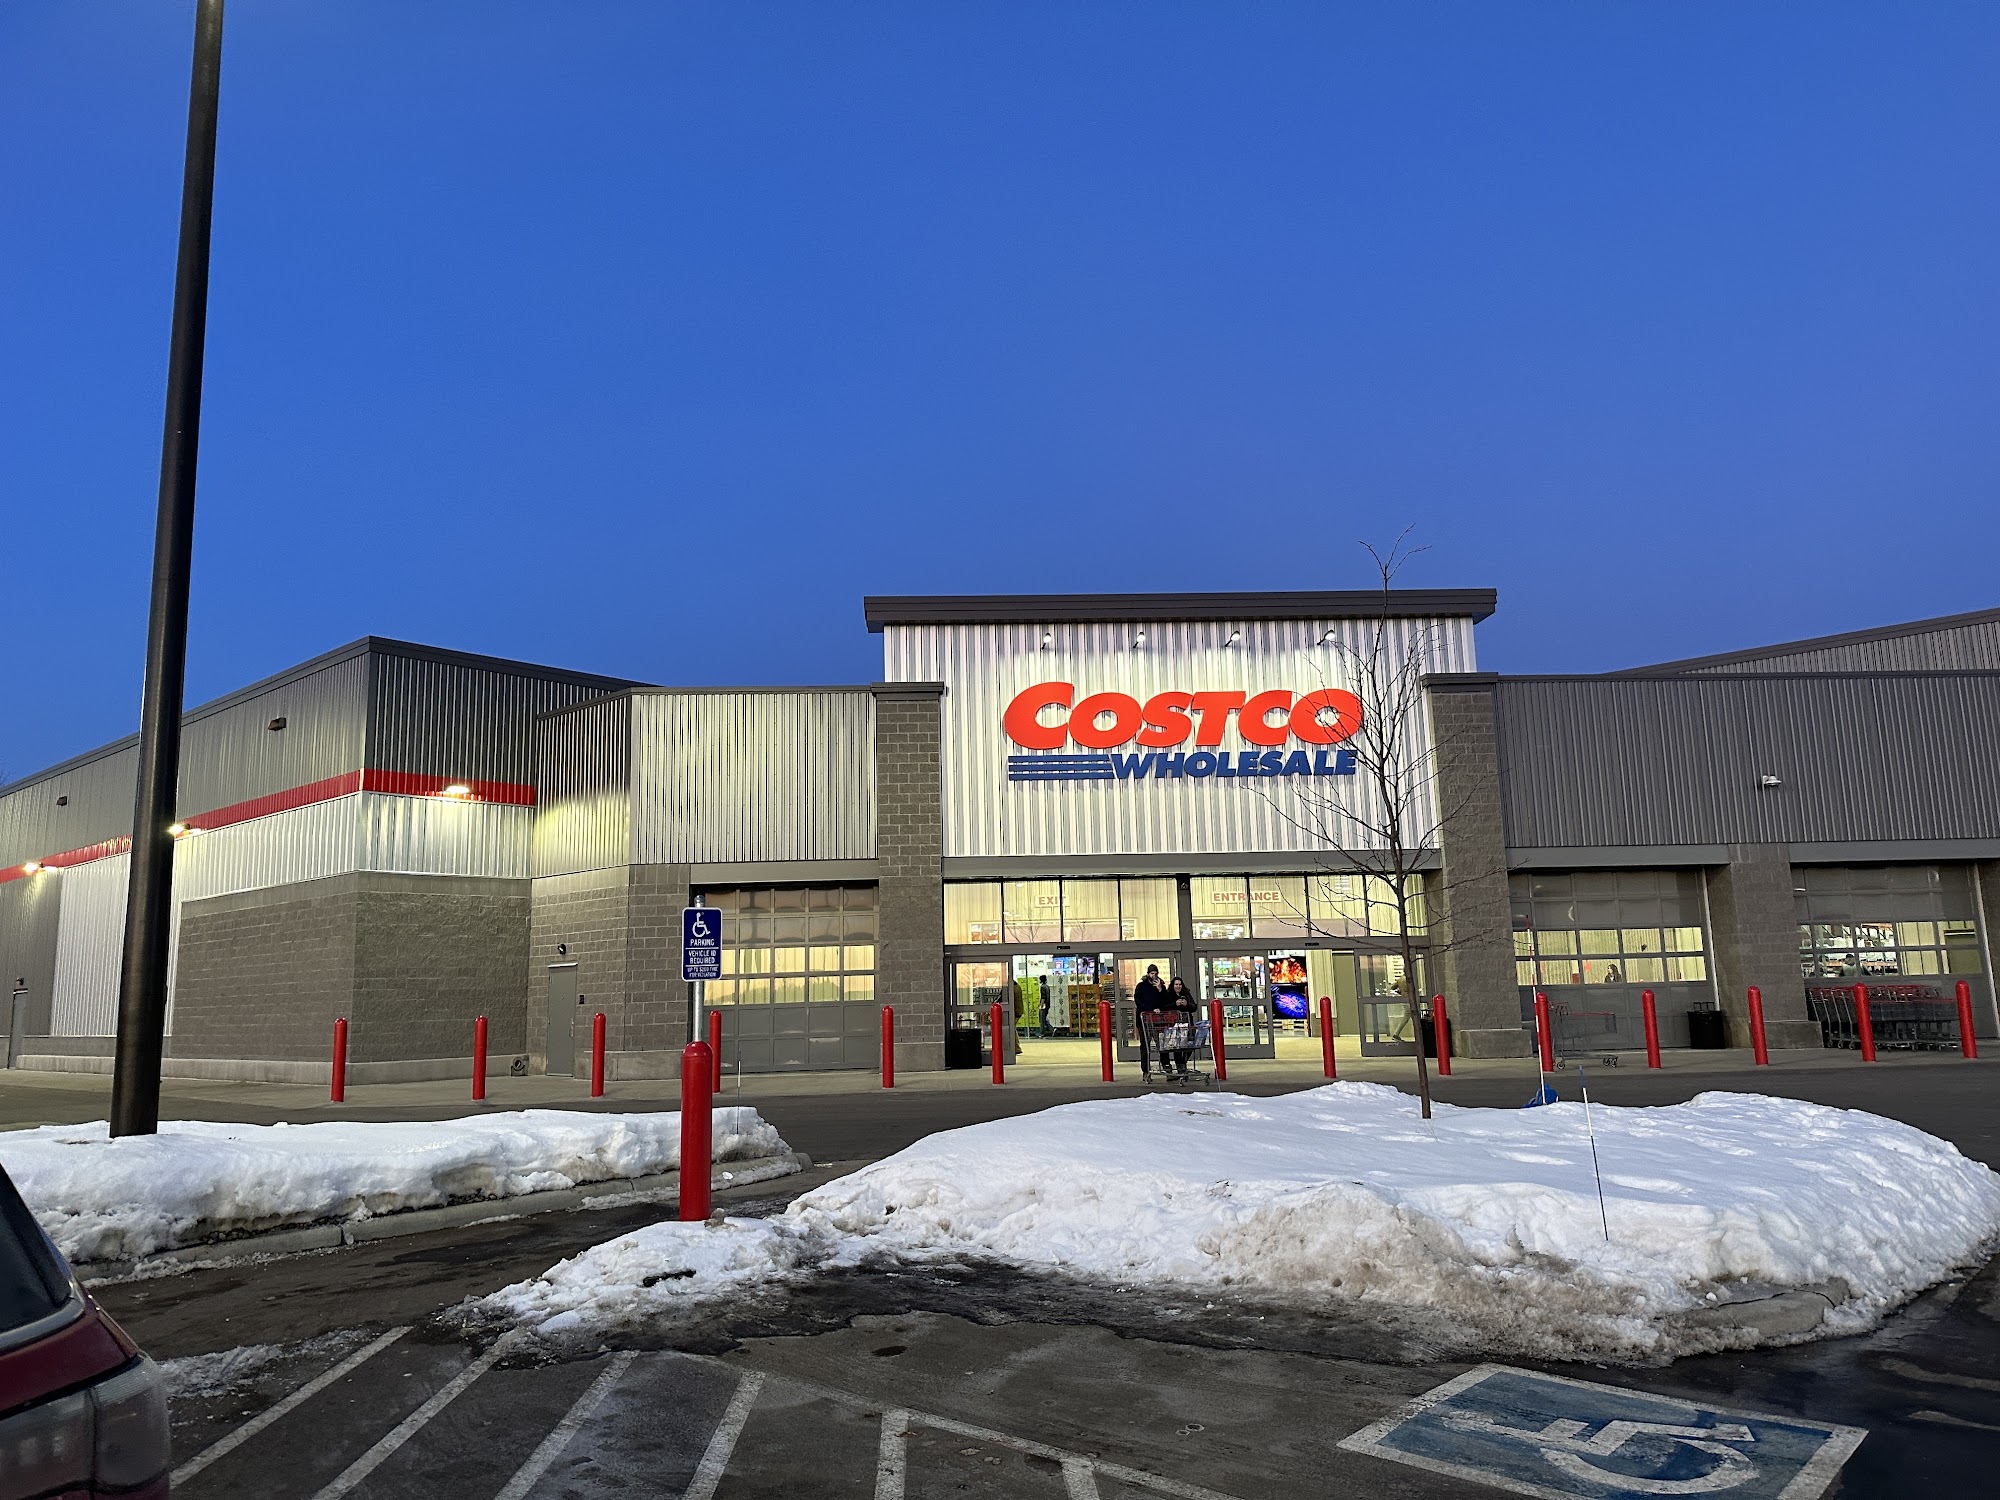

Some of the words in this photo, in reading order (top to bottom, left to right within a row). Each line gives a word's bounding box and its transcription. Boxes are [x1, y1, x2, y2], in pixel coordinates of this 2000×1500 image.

[1003, 681, 1363, 750] COSTCO
[1111, 750, 1356, 779] WHOLESALE
[1213, 892, 1280, 902] ENTRANCE
